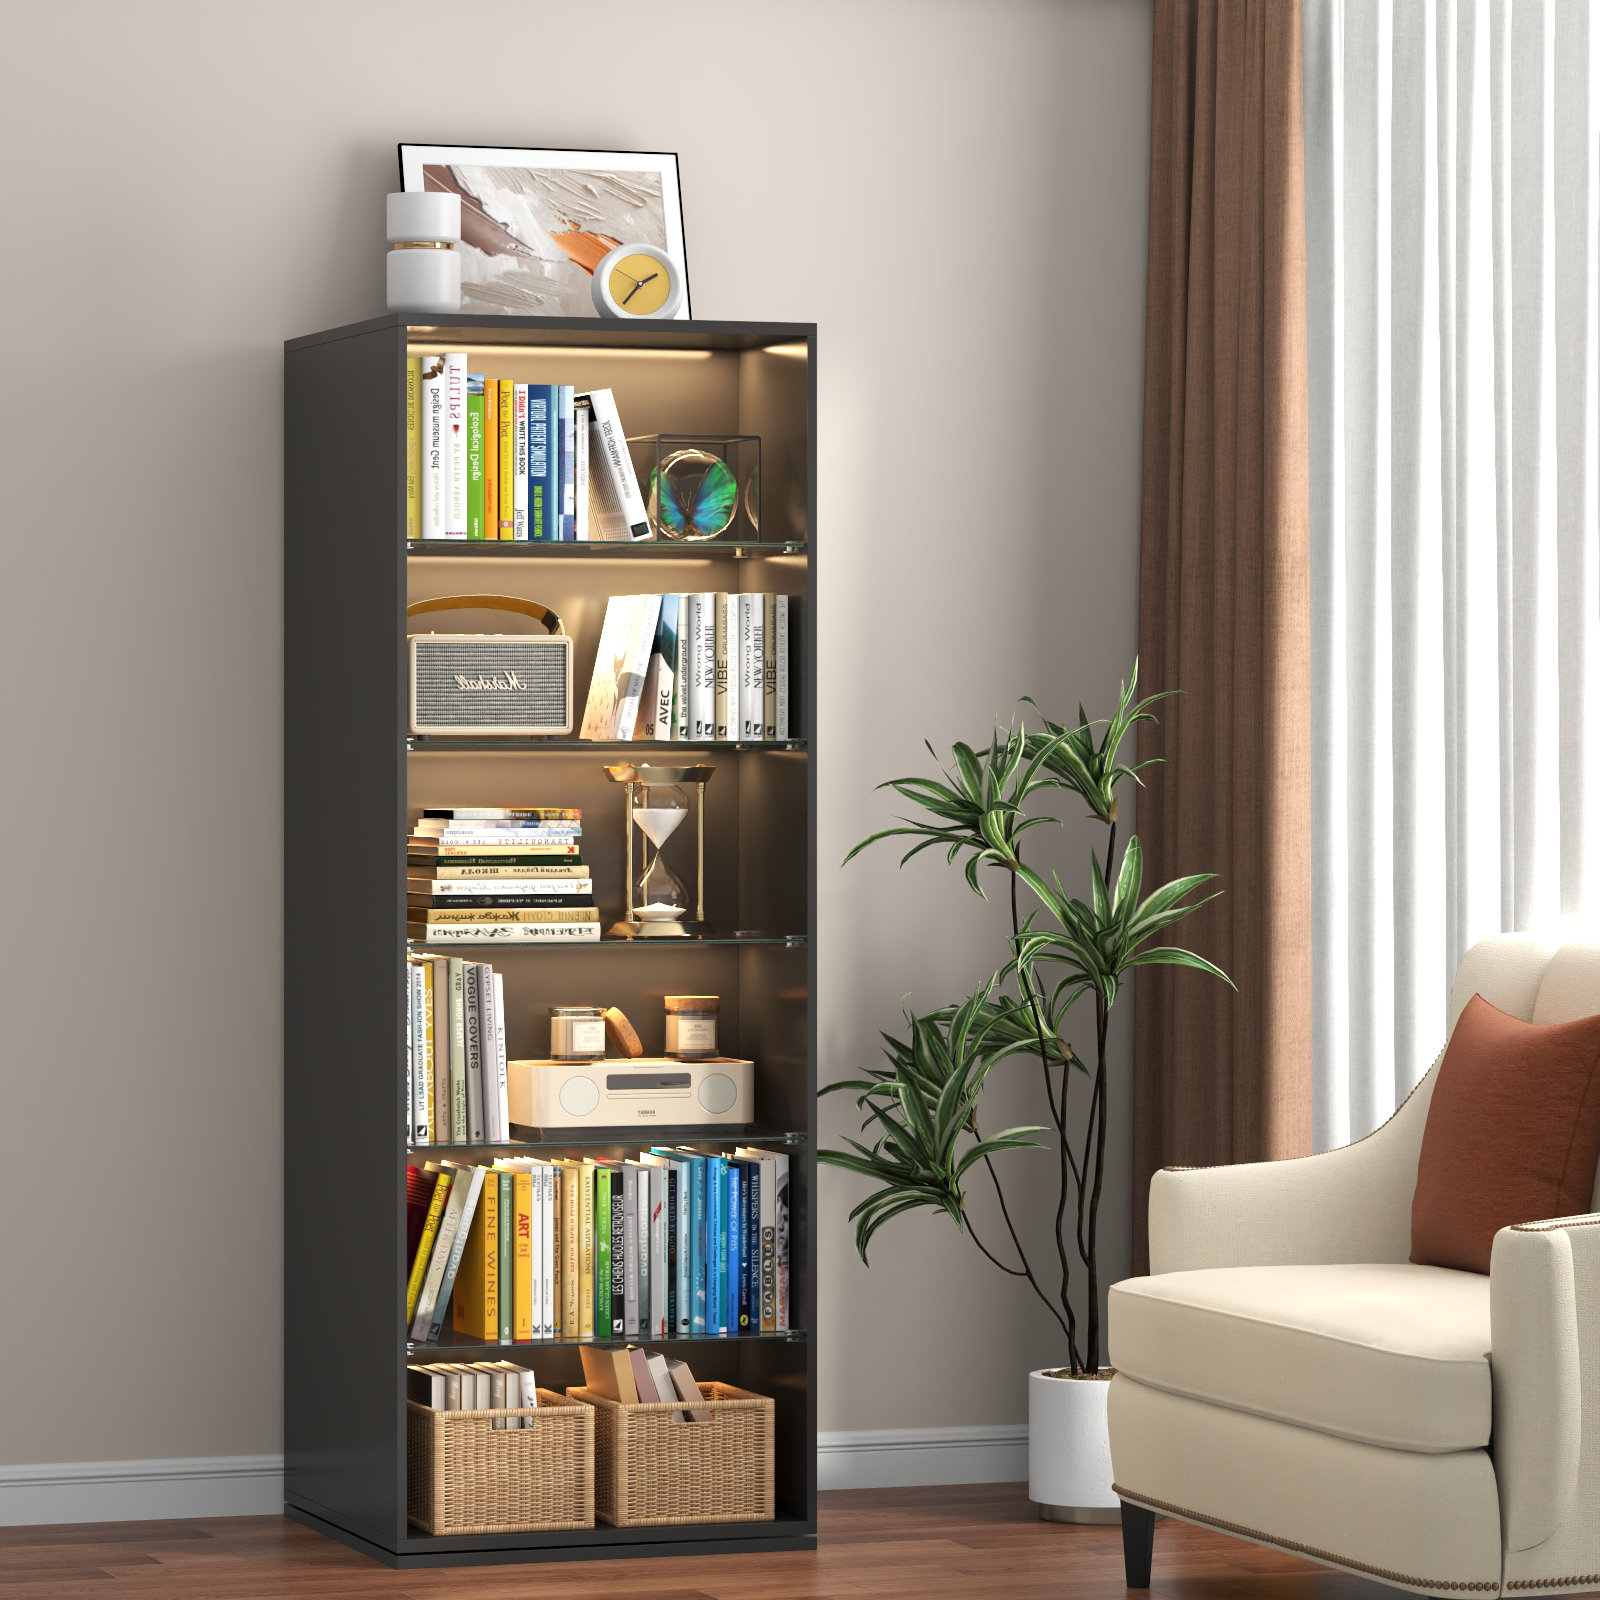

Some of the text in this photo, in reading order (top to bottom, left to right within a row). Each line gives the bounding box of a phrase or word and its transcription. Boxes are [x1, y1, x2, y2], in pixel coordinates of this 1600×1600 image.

[501, 391, 510, 438] Poet Poet
[518, 395, 526, 418] Didn't
[530, 398, 546, 422] VIRTUAL
[518, 420, 526, 440] WRITE
[518, 442, 526, 456] THIS
[530, 422, 546, 444] PATIENT
[518, 457, 526, 475] BOOK
[530, 445, 546, 478] SIMULATION
[680, 640, 688, 684] underground
[706, 626, 716, 689] NEW YORKER
[717, 661, 727, 696] VIBE
[754, 626, 763, 689] NEW YORKER
[766, 661, 776, 696] VIBE
[658, 690, 670, 724] AVEC
[424, 988, 432, 1032] YVES
[467, 966, 479, 1068] VOGUE COVERS
[484, 966, 494, 1040] GYPSET LIVING
[426, 1039, 434, 1092] ABOUT
[497, 1027, 506, 1089] KINFOLK
[424, 1184, 448, 1232] Poet Poet
[488, 1196, 496, 1240] FINE
[519, 1213, 529, 1238] ART
[670, 1224, 676, 1232] BY
[448, 1199, 474, 1278] avantgarde
[612, 1196, 624, 1296] LES CHIENS RETROVISEUR
[640, 1200, 648, 1276] avantgarde
[488, 1251, 496, 1318] WINES
[764, 1230, 772, 1316] FABLES
